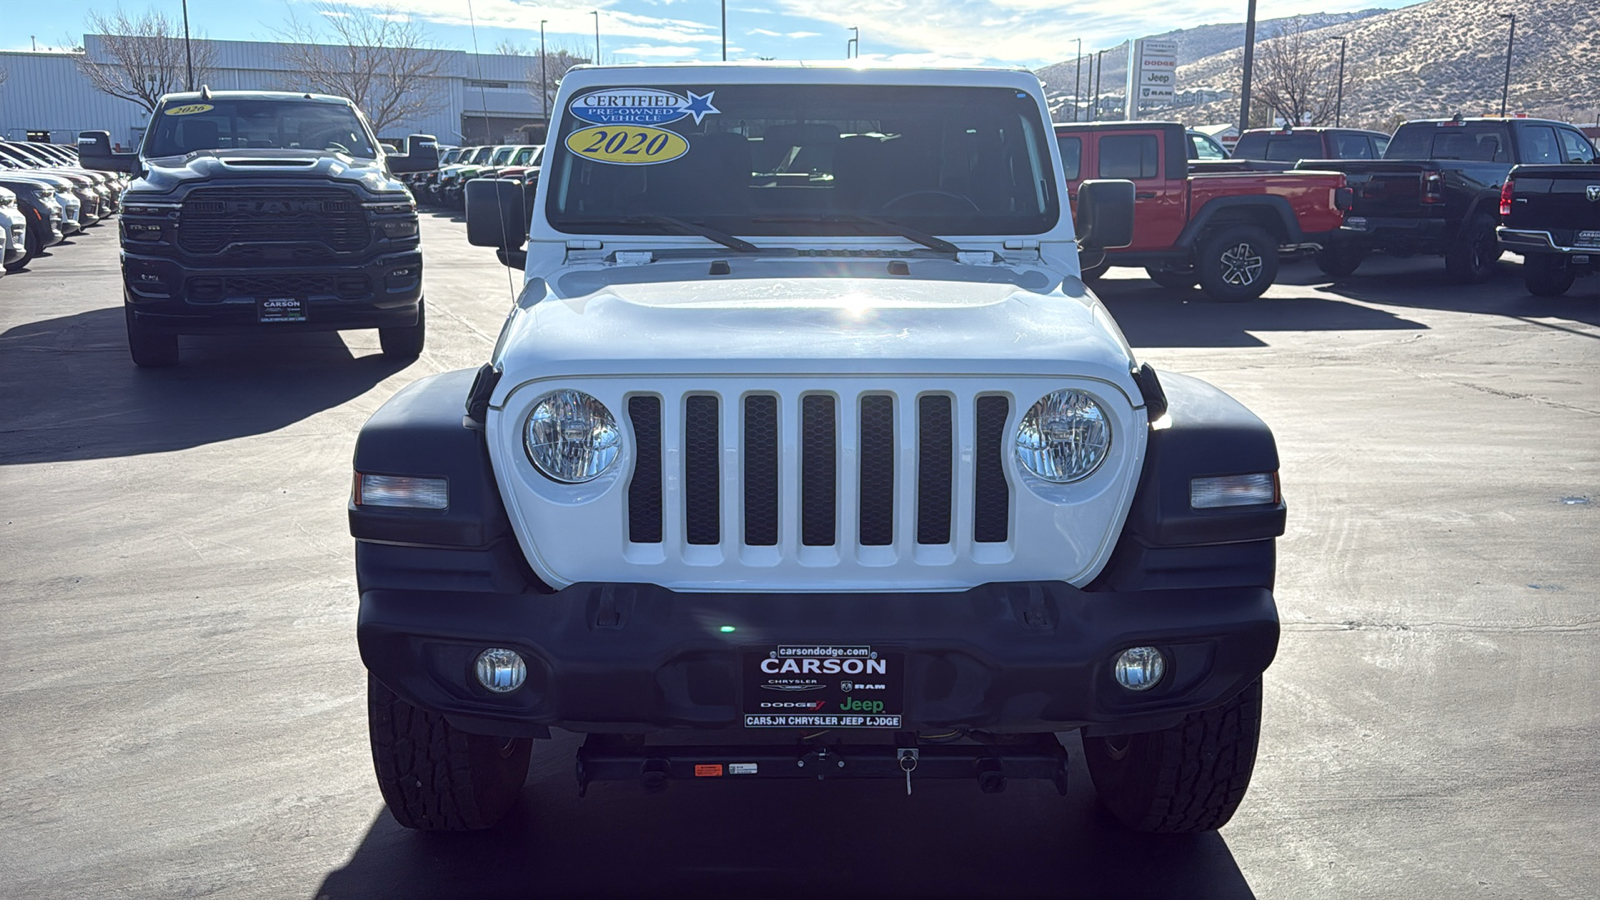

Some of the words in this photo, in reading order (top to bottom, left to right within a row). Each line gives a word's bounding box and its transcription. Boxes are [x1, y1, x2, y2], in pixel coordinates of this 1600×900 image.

[1148, 73, 1169, 83] Jeep
[583, 95, 678, 107] CERTIFIED
[173, 105, 205, 115] 2026
[581, 130, 669, 156] 2020
[779, 647, 868, 656] carsondodge.com
[760, 658, 886, 674] CARSON
[839, 697, 884, 713] Jeep
[788, 717, 838, 726] CHRYSLER
[840, 717, 864, 726] JEEP
